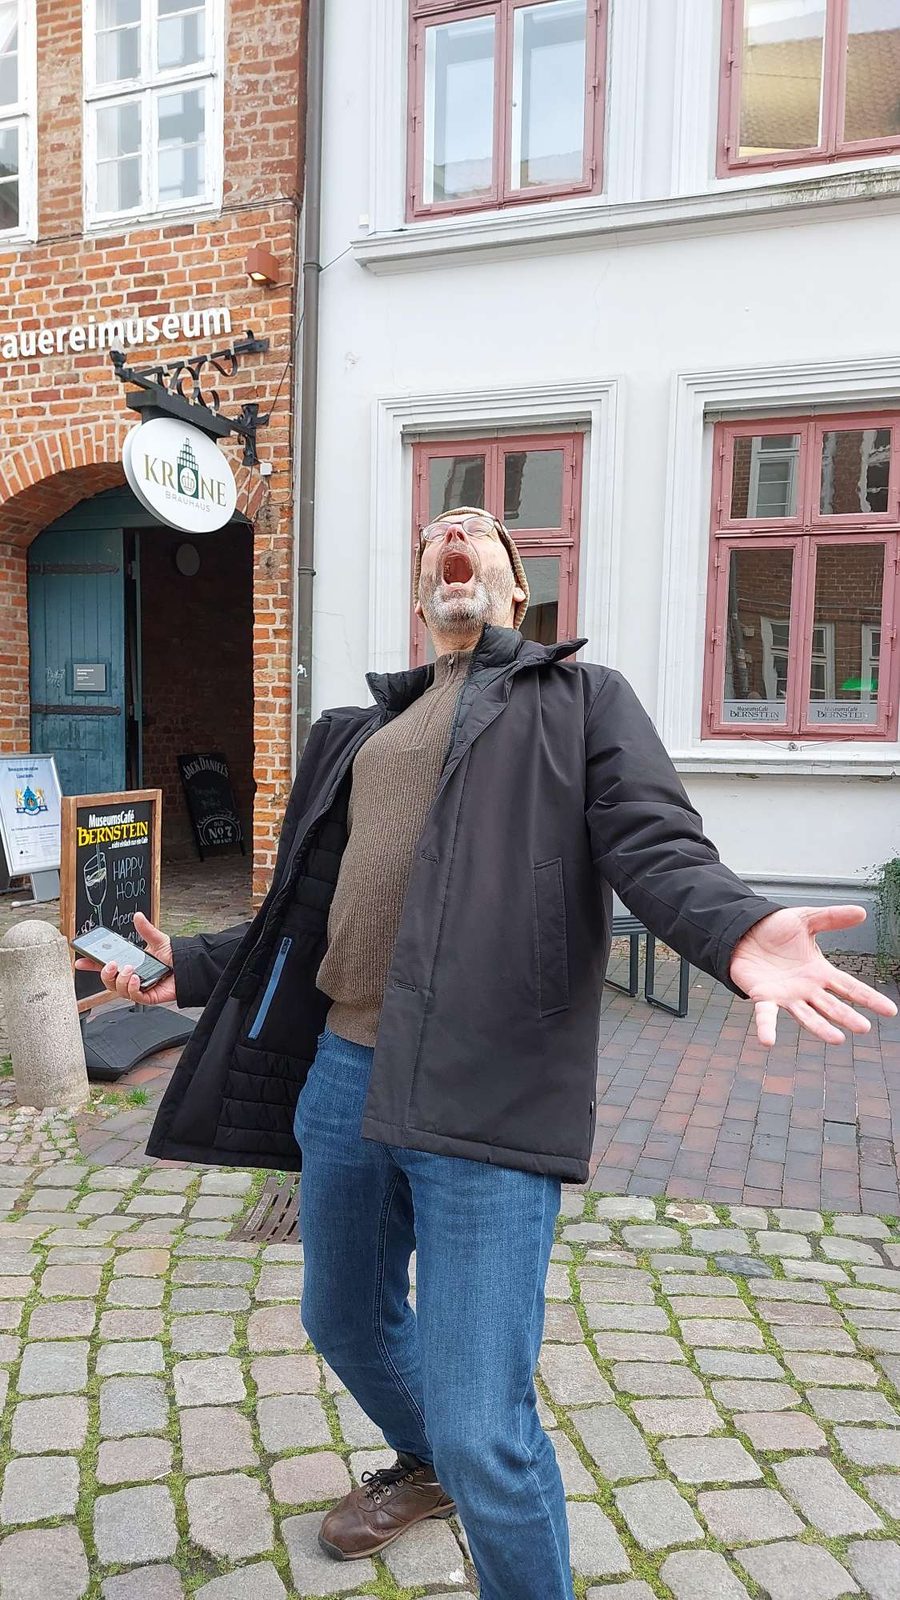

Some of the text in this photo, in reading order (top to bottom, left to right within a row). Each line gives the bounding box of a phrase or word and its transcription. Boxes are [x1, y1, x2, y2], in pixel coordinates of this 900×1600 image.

[0, 307, 232, 359] auereimuseum
[144, 454, 227, 508] KRONE
[165, 490, 211, 513] BRAUHAUS
[730, 710, 780, 718] BERNSTEIN
[183, 760, 200, 780] JACK
[88, 809, 135, 828] MuseumsCafé
[77, 821, 149, 847] BERNSTEIN
[113, 856, 144, 881] HAPPY
[116, 877, 146, 900] HOUR
